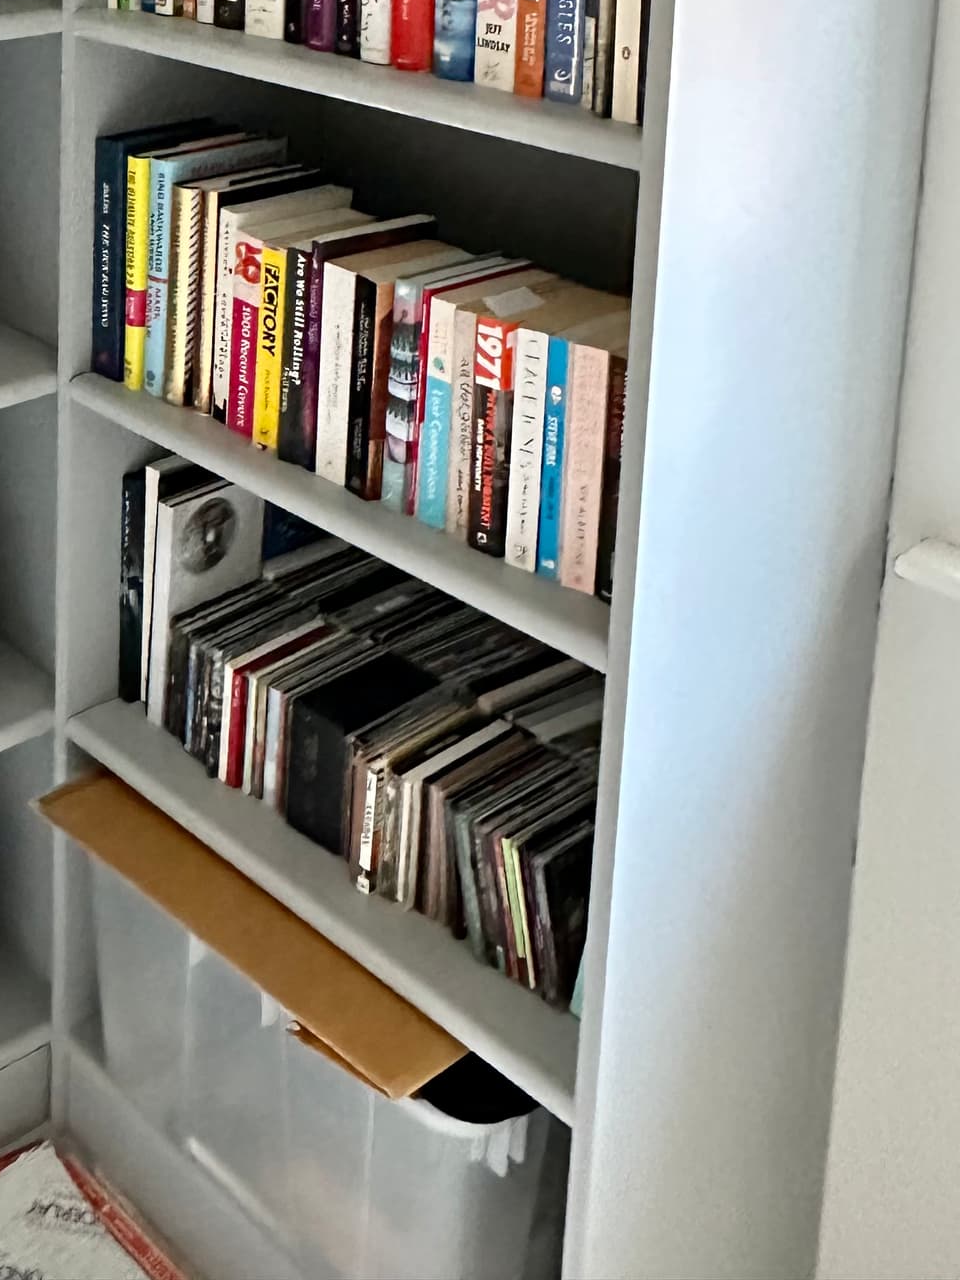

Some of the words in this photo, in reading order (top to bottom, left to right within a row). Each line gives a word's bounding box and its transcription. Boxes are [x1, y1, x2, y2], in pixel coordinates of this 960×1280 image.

[295, 253, 306, 277] Are
[294, 279, 305, 297] We
[241, 304, 252, 338] 1000
[260, 263, 281, 357] FACTORY
[293, 299, 305, 328] Still
[238, 339, 251, 384] Record
[289, 330, 304, 386] Rolling?
[475, 324, 503, 391] 1971
